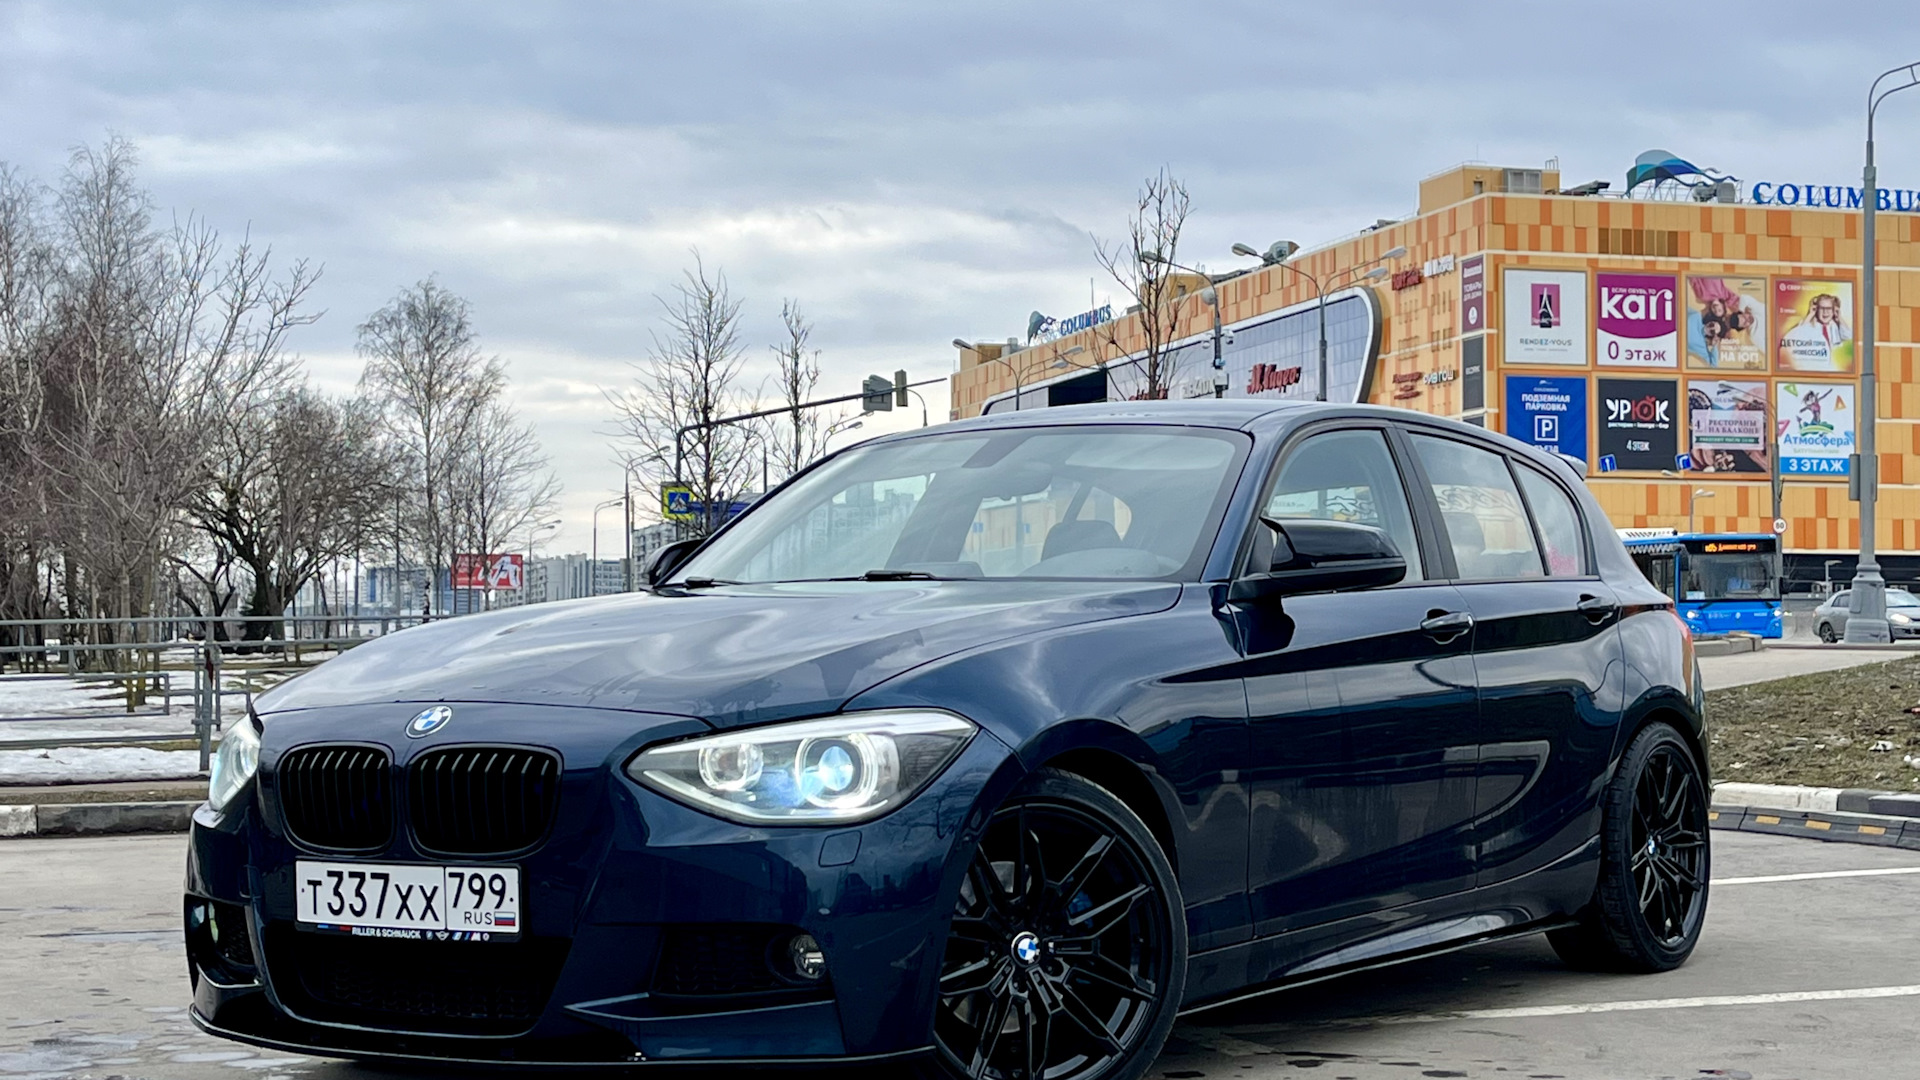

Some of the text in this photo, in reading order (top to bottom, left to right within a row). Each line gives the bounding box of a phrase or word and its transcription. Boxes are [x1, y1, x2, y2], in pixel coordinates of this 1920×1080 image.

[1753, 182, 1920, 211] COLUMBU
[1601, 287, 1673, 320] kari
[1060, 304, 1111, 336] COLUMBUS
[1519, 338, 1572, 346] RENDEZ-VOUS
[1608, 341, 1666, 361] 0 этаж
[1522, 394, 1570, 403] ПОДЗЕМНАЯ
[1525, 402, 1567, 411] ПАРКОВКА
[1606, 396, 1670, 422] УРЮК
[1784, 433, 1850, 447] Атмосфера
[1789, 459, 1844, 472] 3 ЭТАЖ
[307, 870, 440, 922] Т337ХХ
[448, 872, 507, 909] 799
[464, 911, 493, 925] RUS
